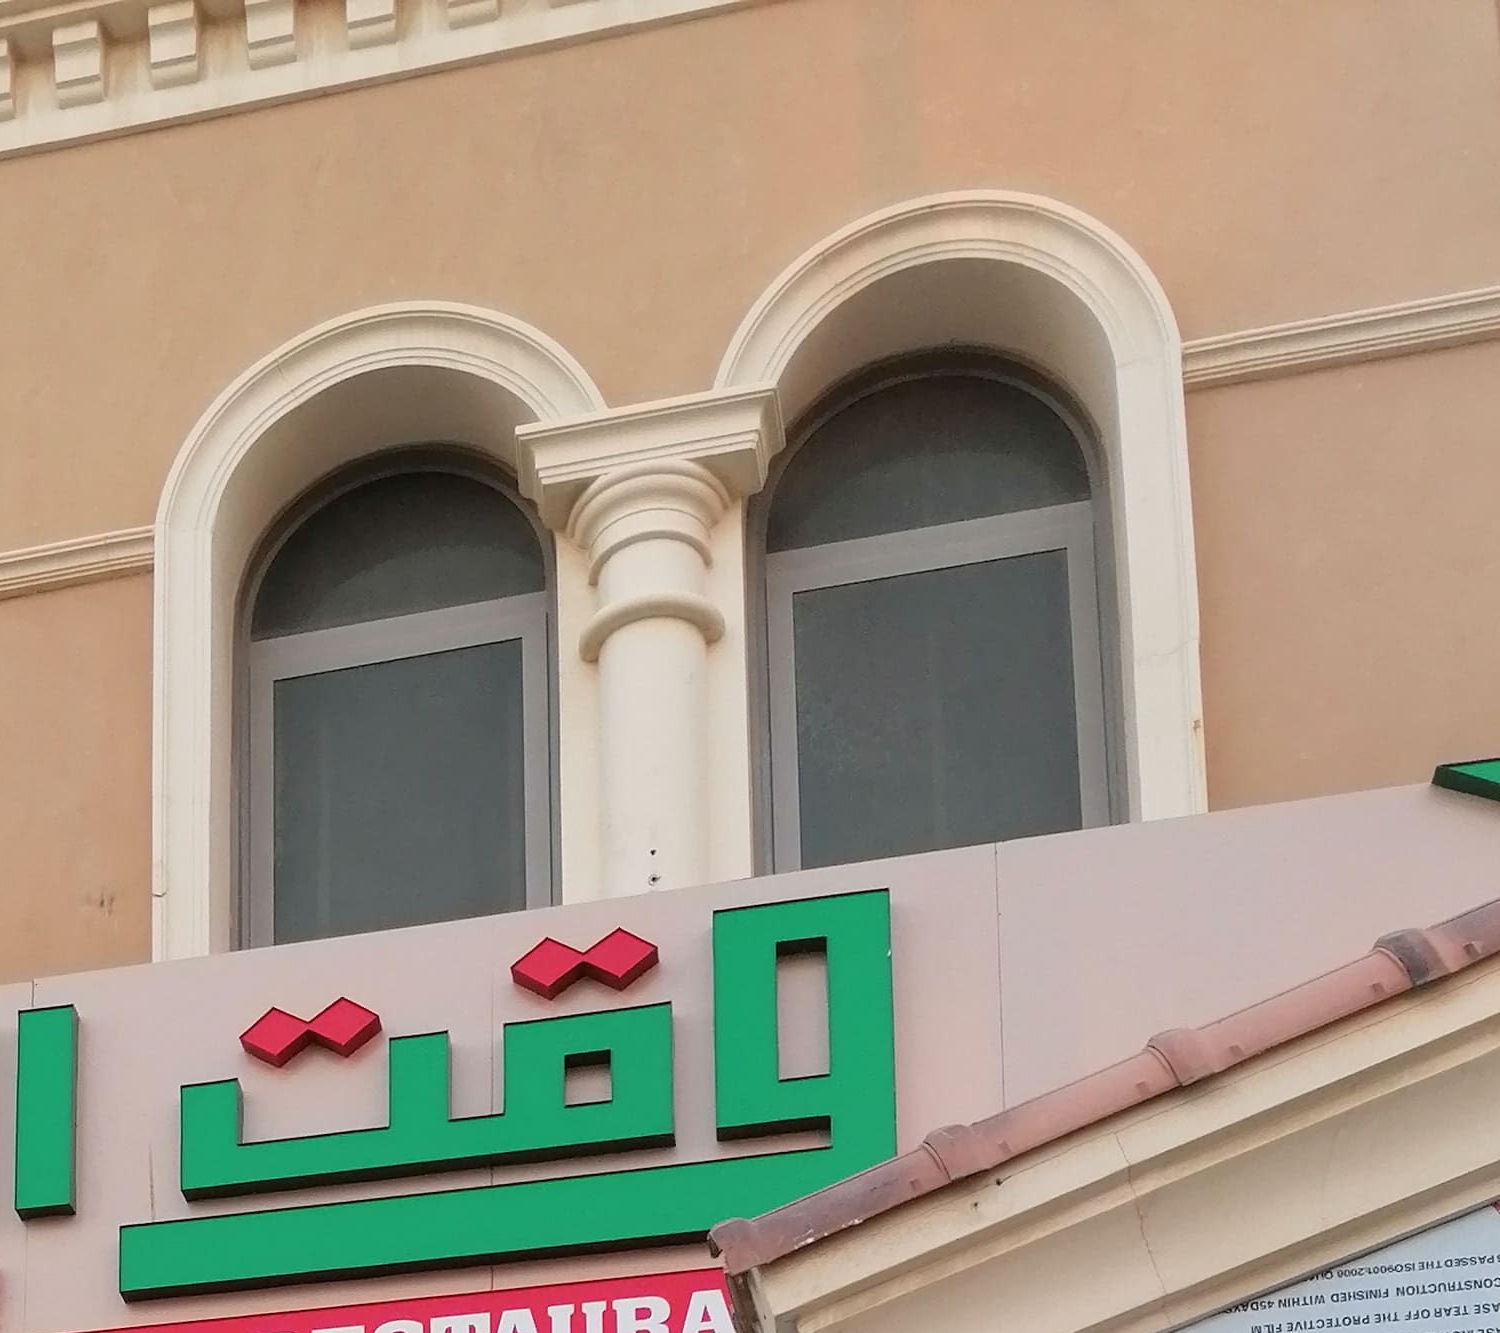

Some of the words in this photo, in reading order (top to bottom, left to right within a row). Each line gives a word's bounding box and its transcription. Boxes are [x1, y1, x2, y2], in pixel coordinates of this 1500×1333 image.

[118, 888, 897, 1302] وقت
[1277, 1293, 1326, 1309] WITHIN
[1331, 1288, 1389, 1305] FINISHED
[1374, 1311, 1401, 1325] THE
[1405, 1307, 1430, 1321] OFF
[1433, 1302, 1469, 1318] TEAR
[1286, 1314, 1371, 1333] PROTECTIVE
